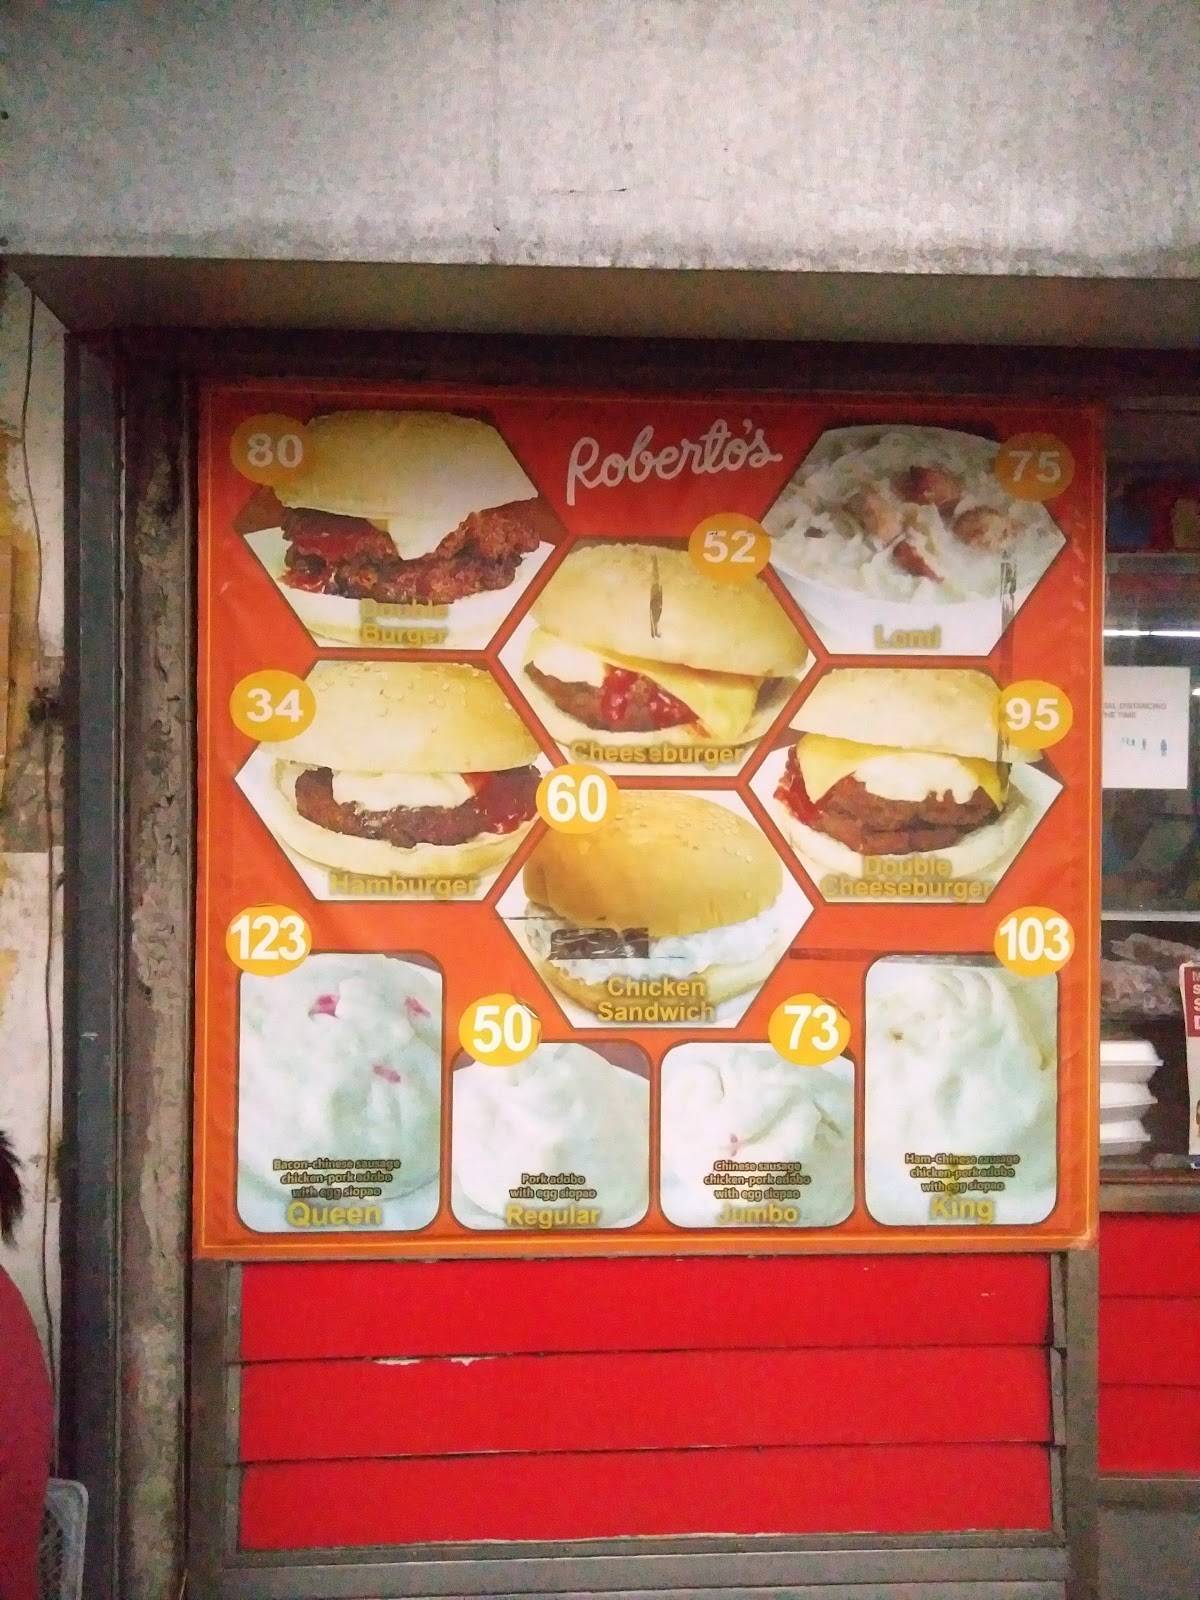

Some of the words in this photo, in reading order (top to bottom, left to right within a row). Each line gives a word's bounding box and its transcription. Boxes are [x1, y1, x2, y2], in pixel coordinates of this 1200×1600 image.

[246, 432, 303, 468] 80
[566, 419, 783, 506] Roberto's
[1008, 450, 1062, 483] 75
[703, 530, 756, 563] 52
[361, 623, 447, 647] Burger
[246, 687, 303, 723] 34
[1005, 697, 1060, 732] 95
[571, 741, 743, 768] Cheeseburger
[546, 773, 608, 824] 60
[865, 854, 951, 876] Double
[330, 871, 479, 899] Hamburger
[820, 876, 994, 901] Cheeseburger
[230, 914, 306, 961] 123
[999, 917, 1070, 962] 103
[607, 975, 706, 997] Chicken
[598, 1001, 714, 1022] Sandwich
[473, 1004, 532, 1053] 50
[784, 1005, 840, 1051] 73
[355, 1159, 401, 1173] sausage
[758, 1161, 801, 1175] sausage
[978, 1154, 1020, 1167] sausage
[280, 1171, 354, 1184] chicken-pork
[356, 1171, 393, 1182] adobo
[521, 1173, 549, 1185] Pork
[550, 1173, 586, 1184] adobo
[704, 1174, 775, 1187] chicken-pork
[776, 1174, 812, 1185] adobo
[910, 1167, 980, 1180] chicken-pork
[981, 1167, 1015, 1178] adobo
[291, 1186, 318, 1198] with
[319, 1187, 342, 1200] egg
[509, 1186, 534, 1198] with
[536, 1189, 558, 1201] egg
[559, 1186, 597, 1200] siopao
[714, 1187, 739, 1200] with
[741, 1189, 763, 1201] egg
[764, 1187, 800, 1201] siopao
[921, 1180, 945, 1192] with
[946, 1182, 967, 1195] egg
[968, 1180, 1005, 1193] siopao
[287, 1200, 382, 1227] Queen
[506, 1205, 599, 1230] Regular
[719, 1203, 798, 1224] Jumbo
[931, 1196, 994, 1224] King
